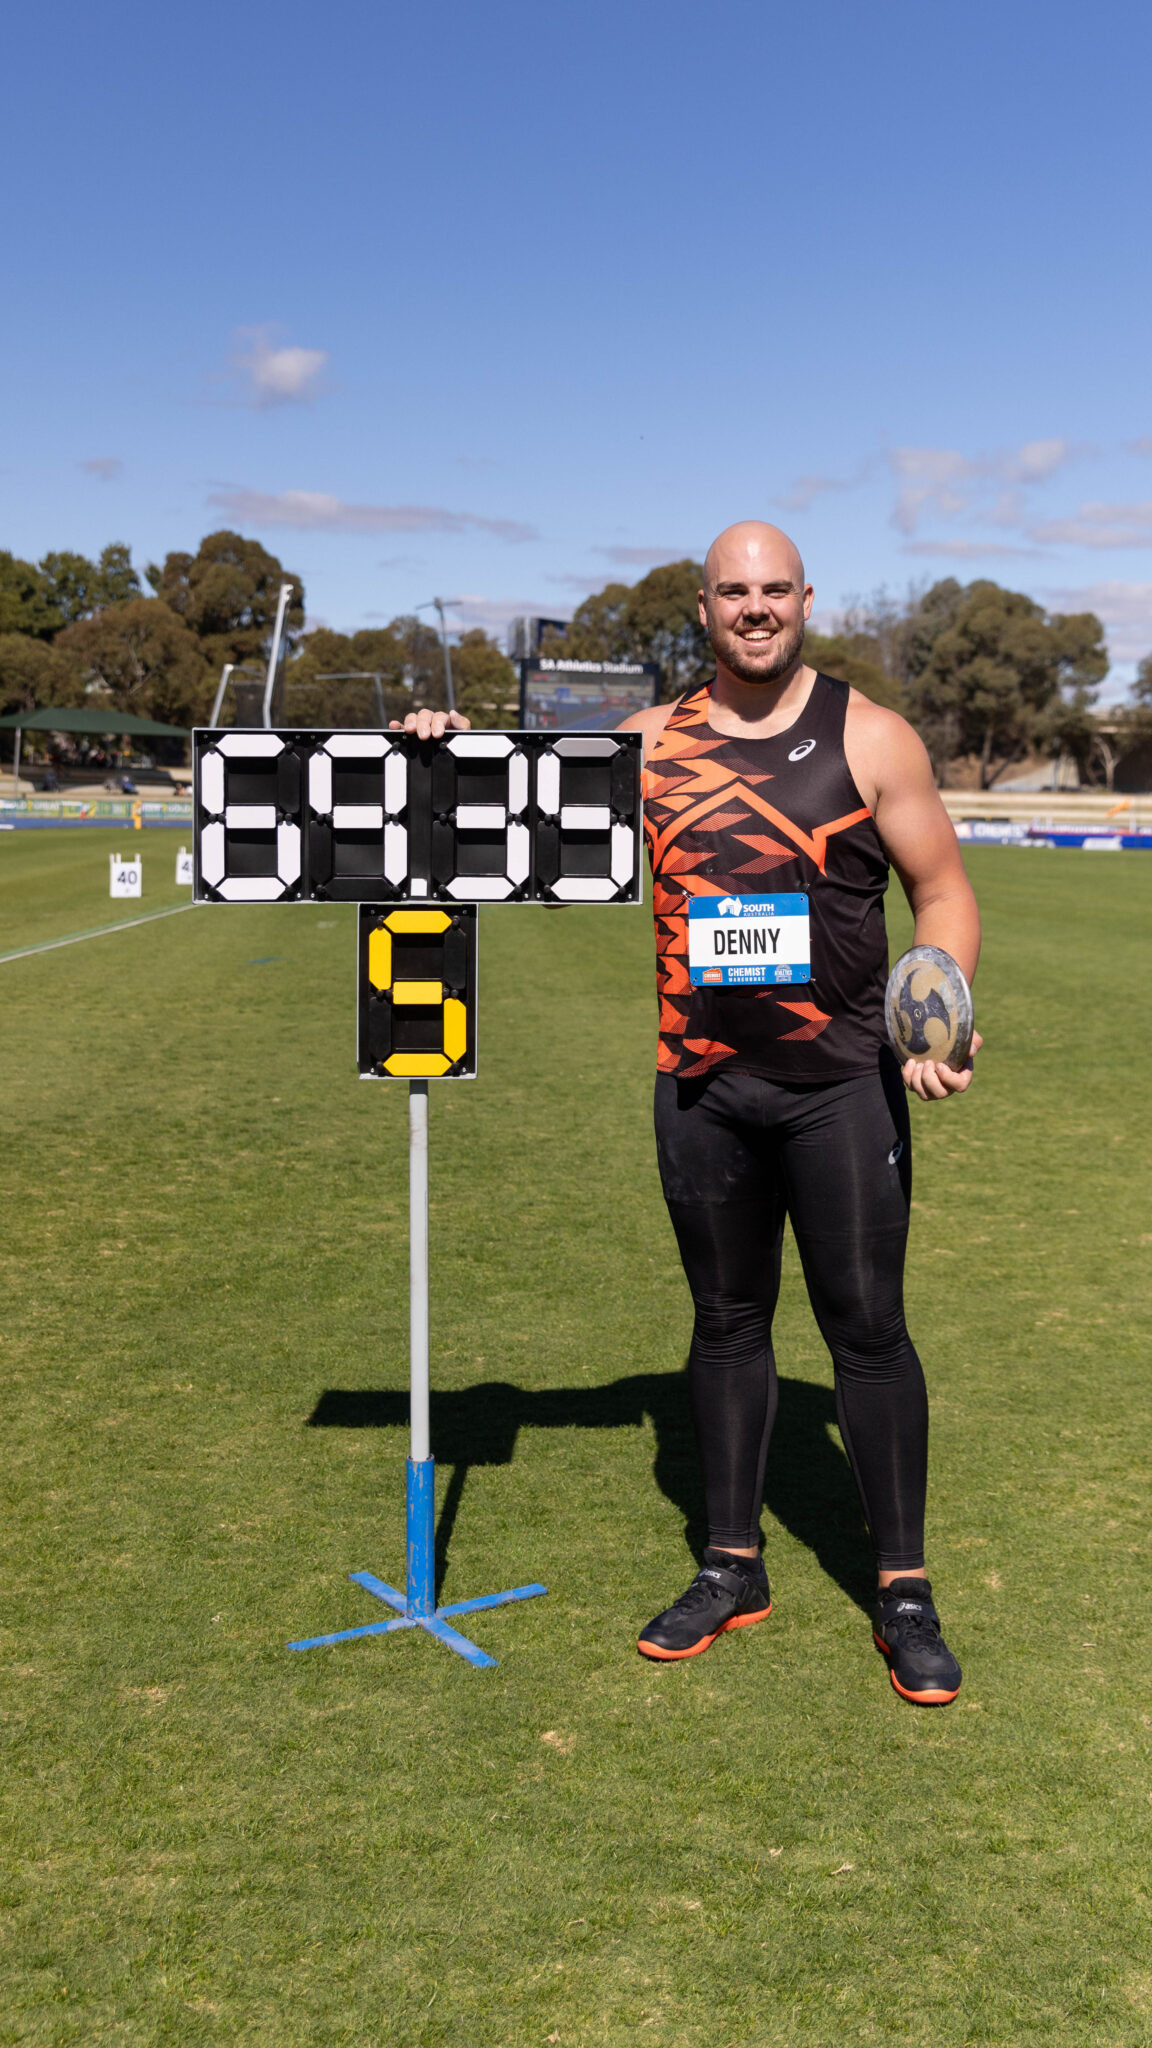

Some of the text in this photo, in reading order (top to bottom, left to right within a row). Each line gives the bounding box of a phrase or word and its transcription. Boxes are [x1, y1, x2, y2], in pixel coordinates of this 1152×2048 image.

[540, 658, 644, 675] SA Athletics Stadium
[117, 870, 138, 885] 40
[743, 903, 774, 912] SOUTH
[714, 928, 781, 955] DENNY
[728, 967, 766, 977] CHEMIST
[368, 910, 468, 1077] 5
